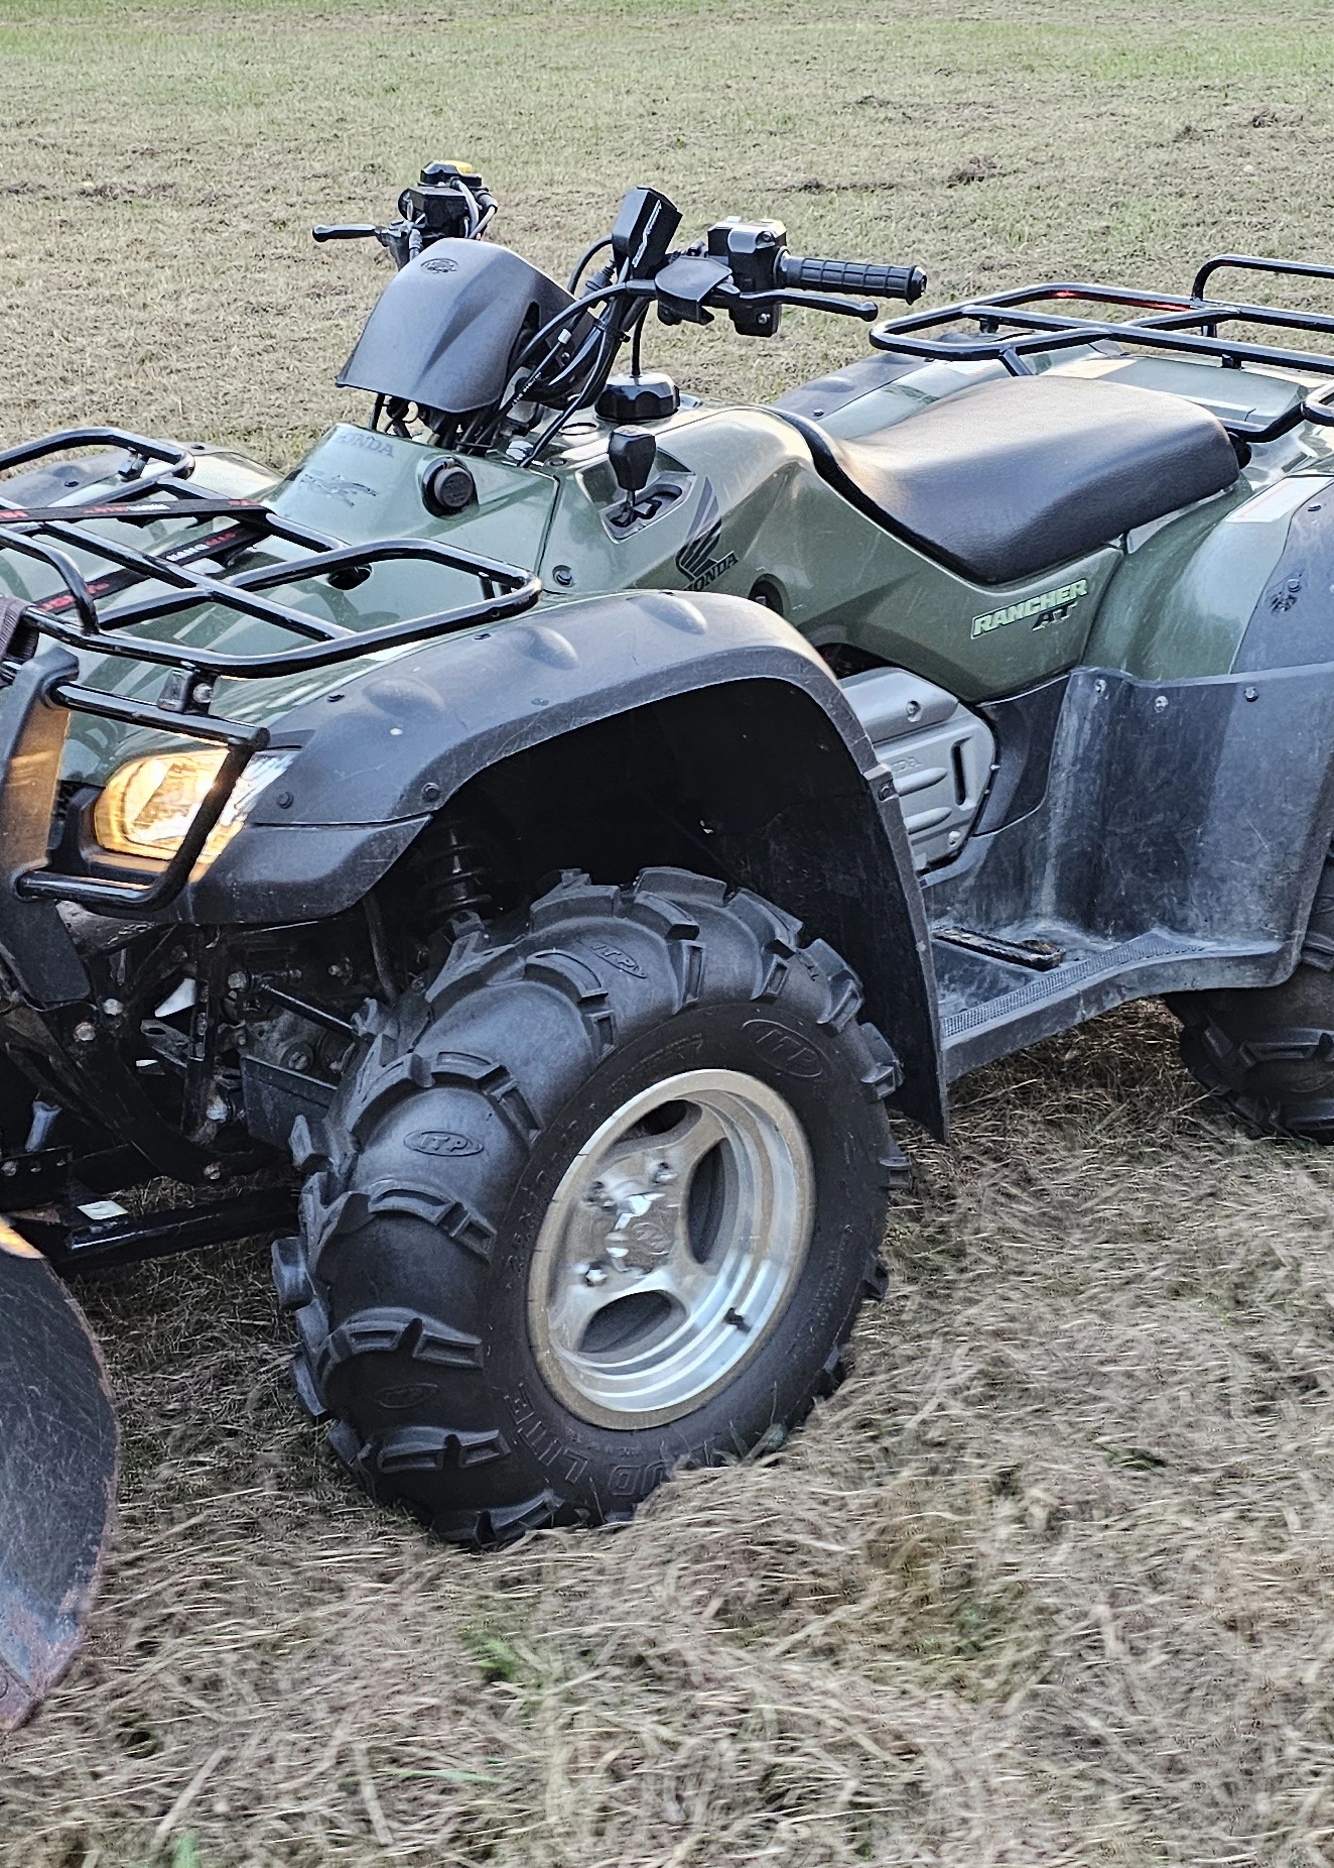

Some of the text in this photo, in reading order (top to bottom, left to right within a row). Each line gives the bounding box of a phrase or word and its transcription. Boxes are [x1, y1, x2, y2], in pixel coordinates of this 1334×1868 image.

[338, 432, 395, 459] ONDA
[971, 578, 1088, 638] RANCHER
[1031, 601, 1078, 631] AT
[589, 944, 636, 968] ITP
[754, 1029, 819, 1067] ITP
[420, 1134, 468, 1152] ITP
[503, 1382, 589, 1485] LITE
[607, 1461, 667, 1496] UD
